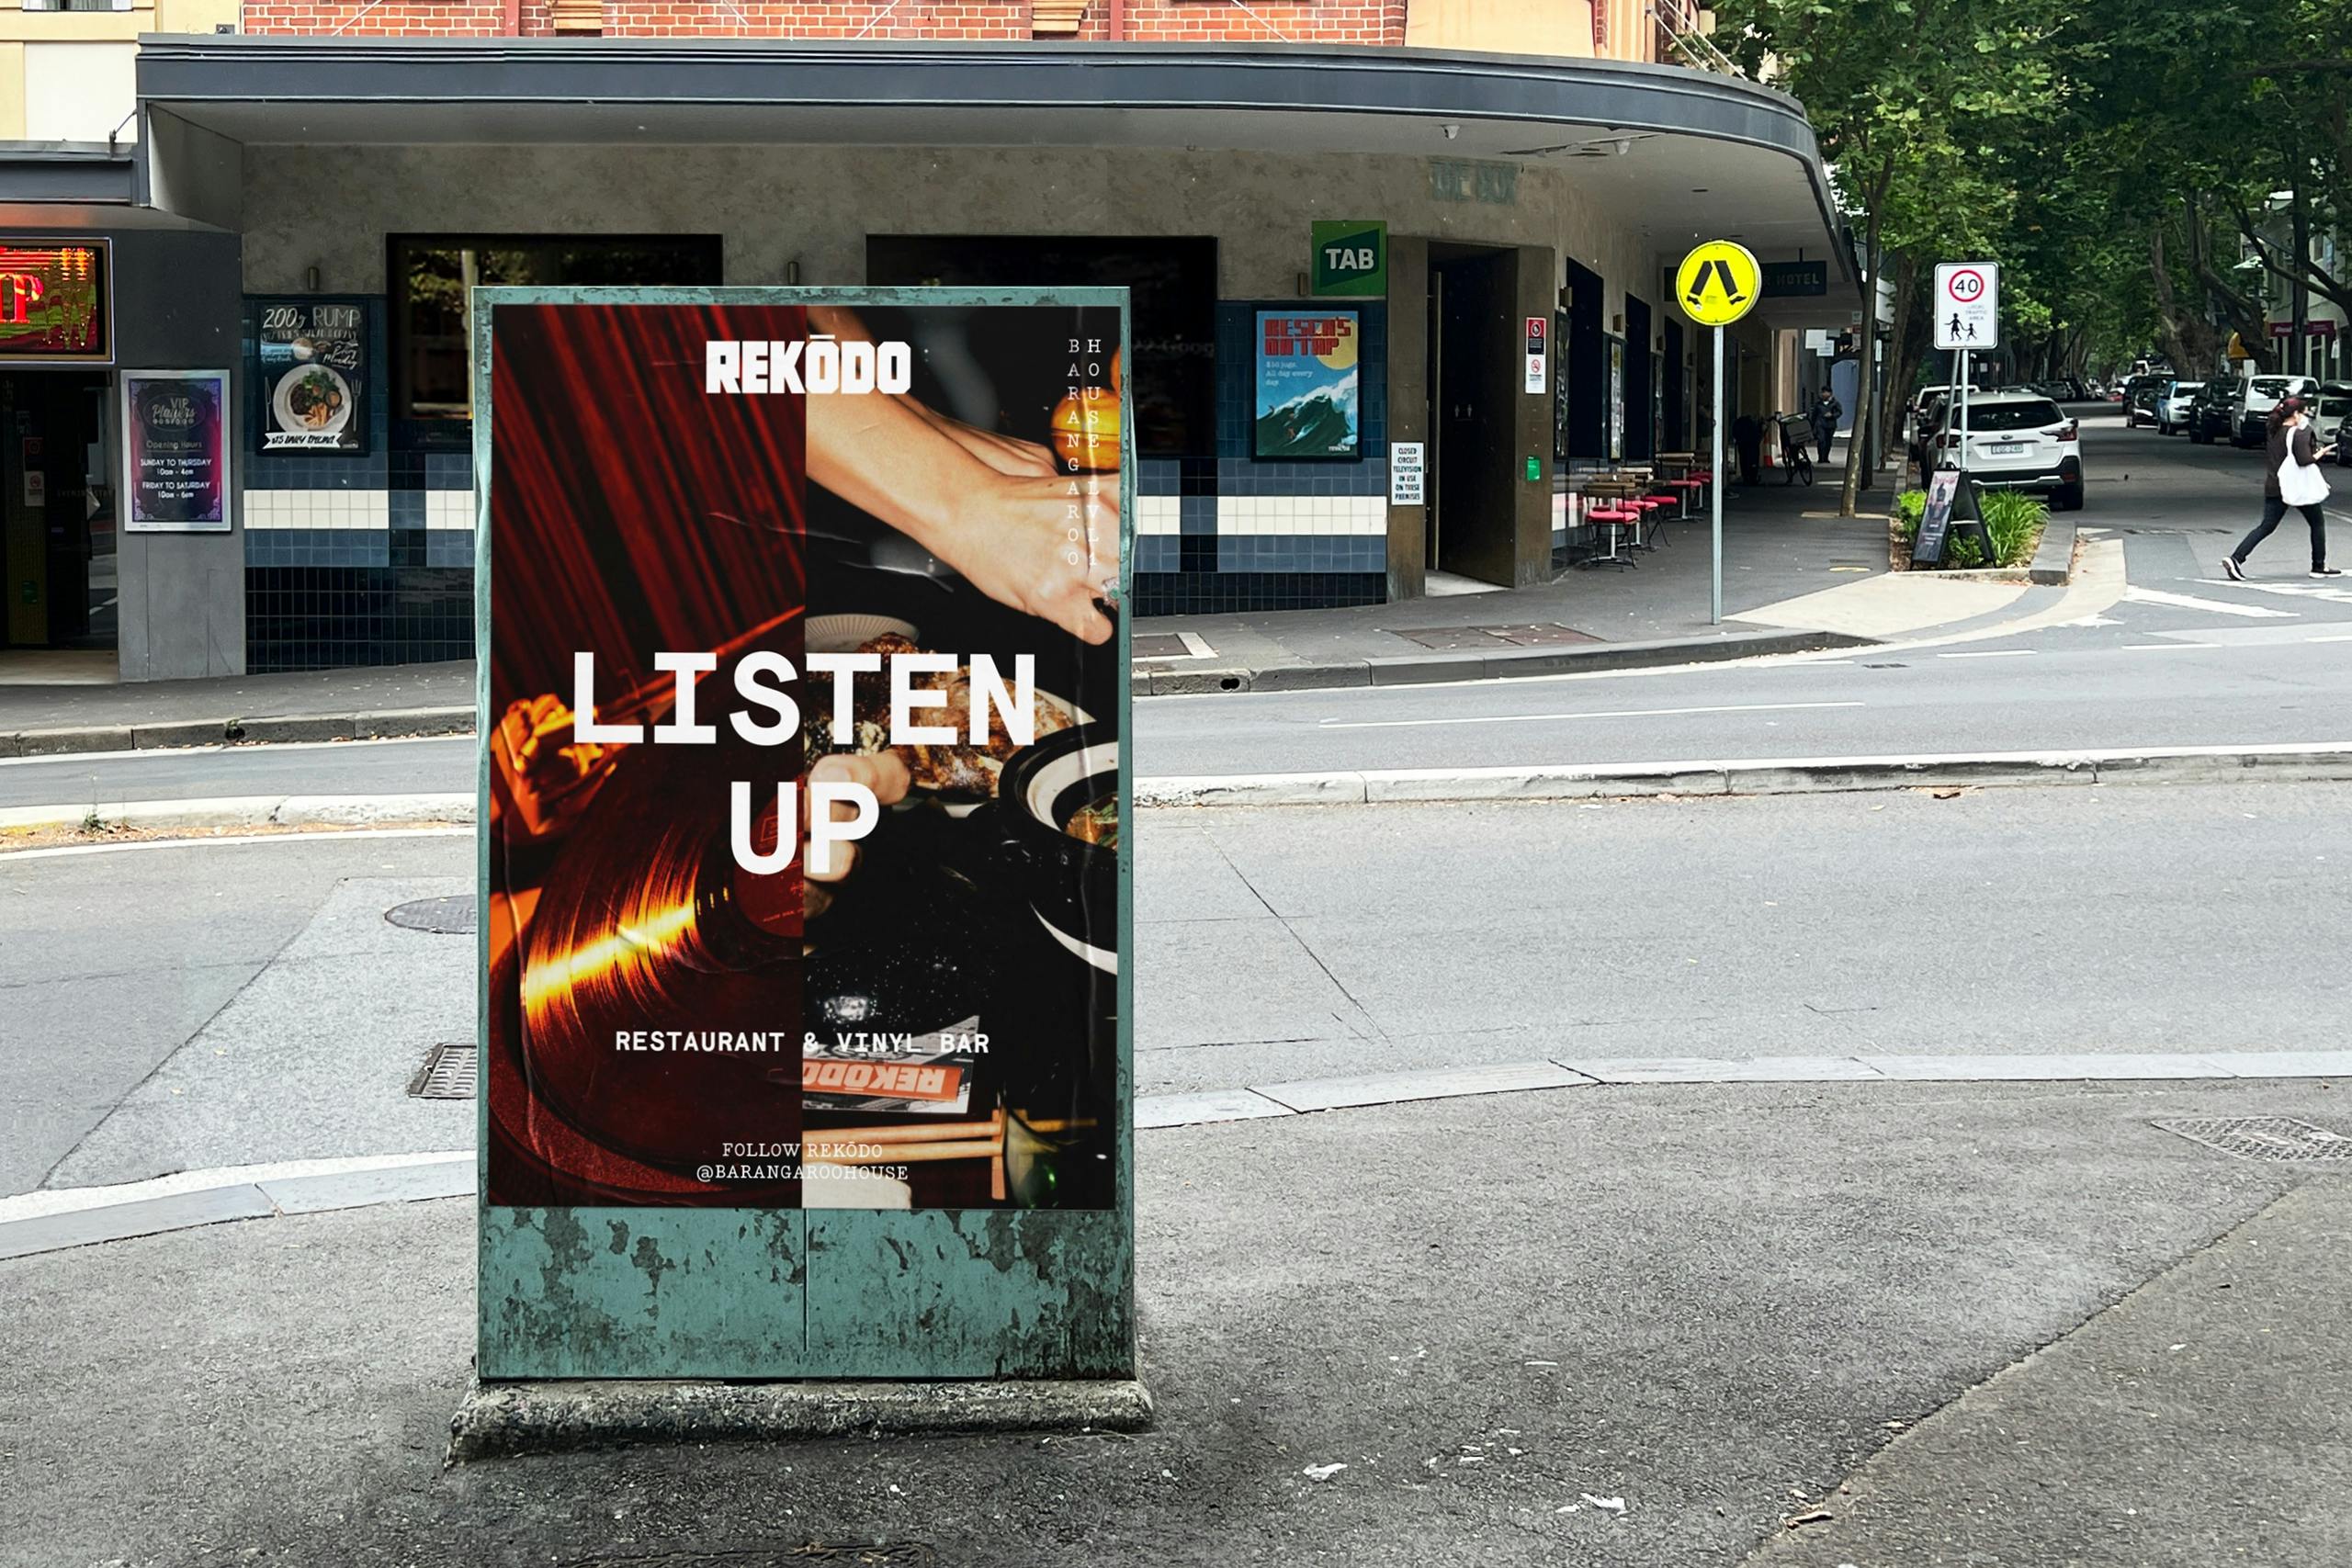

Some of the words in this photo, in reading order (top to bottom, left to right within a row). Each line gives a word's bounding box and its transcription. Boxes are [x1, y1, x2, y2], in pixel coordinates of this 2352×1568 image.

[1325, 248, 1374, 270] TAB
[1776, 272, 1820, 286] HOTEL
[1954, 278, 1979, 293] 40
[312, 307, 361, 328] RUMP
[1295, 337, 1340, 356] TAP
[706, 334, 910, 395] REKŌDO
[1277, 370, 1291, 378] day
[1292, 370, 1314, 378] every
[170, 398, 189, 409] VIP
[1087, 339, 1102, 448] HOUSE
[146, 440, 178, 449] Opening
[1067, 339, 1080, 566] BARANGAROO
[573, 650, 1035, 747] LISTEN
[730, 781, 879, 874] UP
[616, 1032, 785, 1052] RESTAURANT
[804, 1032, 819, 1052] &
[837, 1032, 922, 1053] VINYL
[940, 1033, 989, 1054] BAR
[722, 1142, 802, 1157] FOLLOW
[807, 1140, 883, 1157] REKŌDO
[696, 1163, 908, 1182] @BARANGAROOHOUSE
